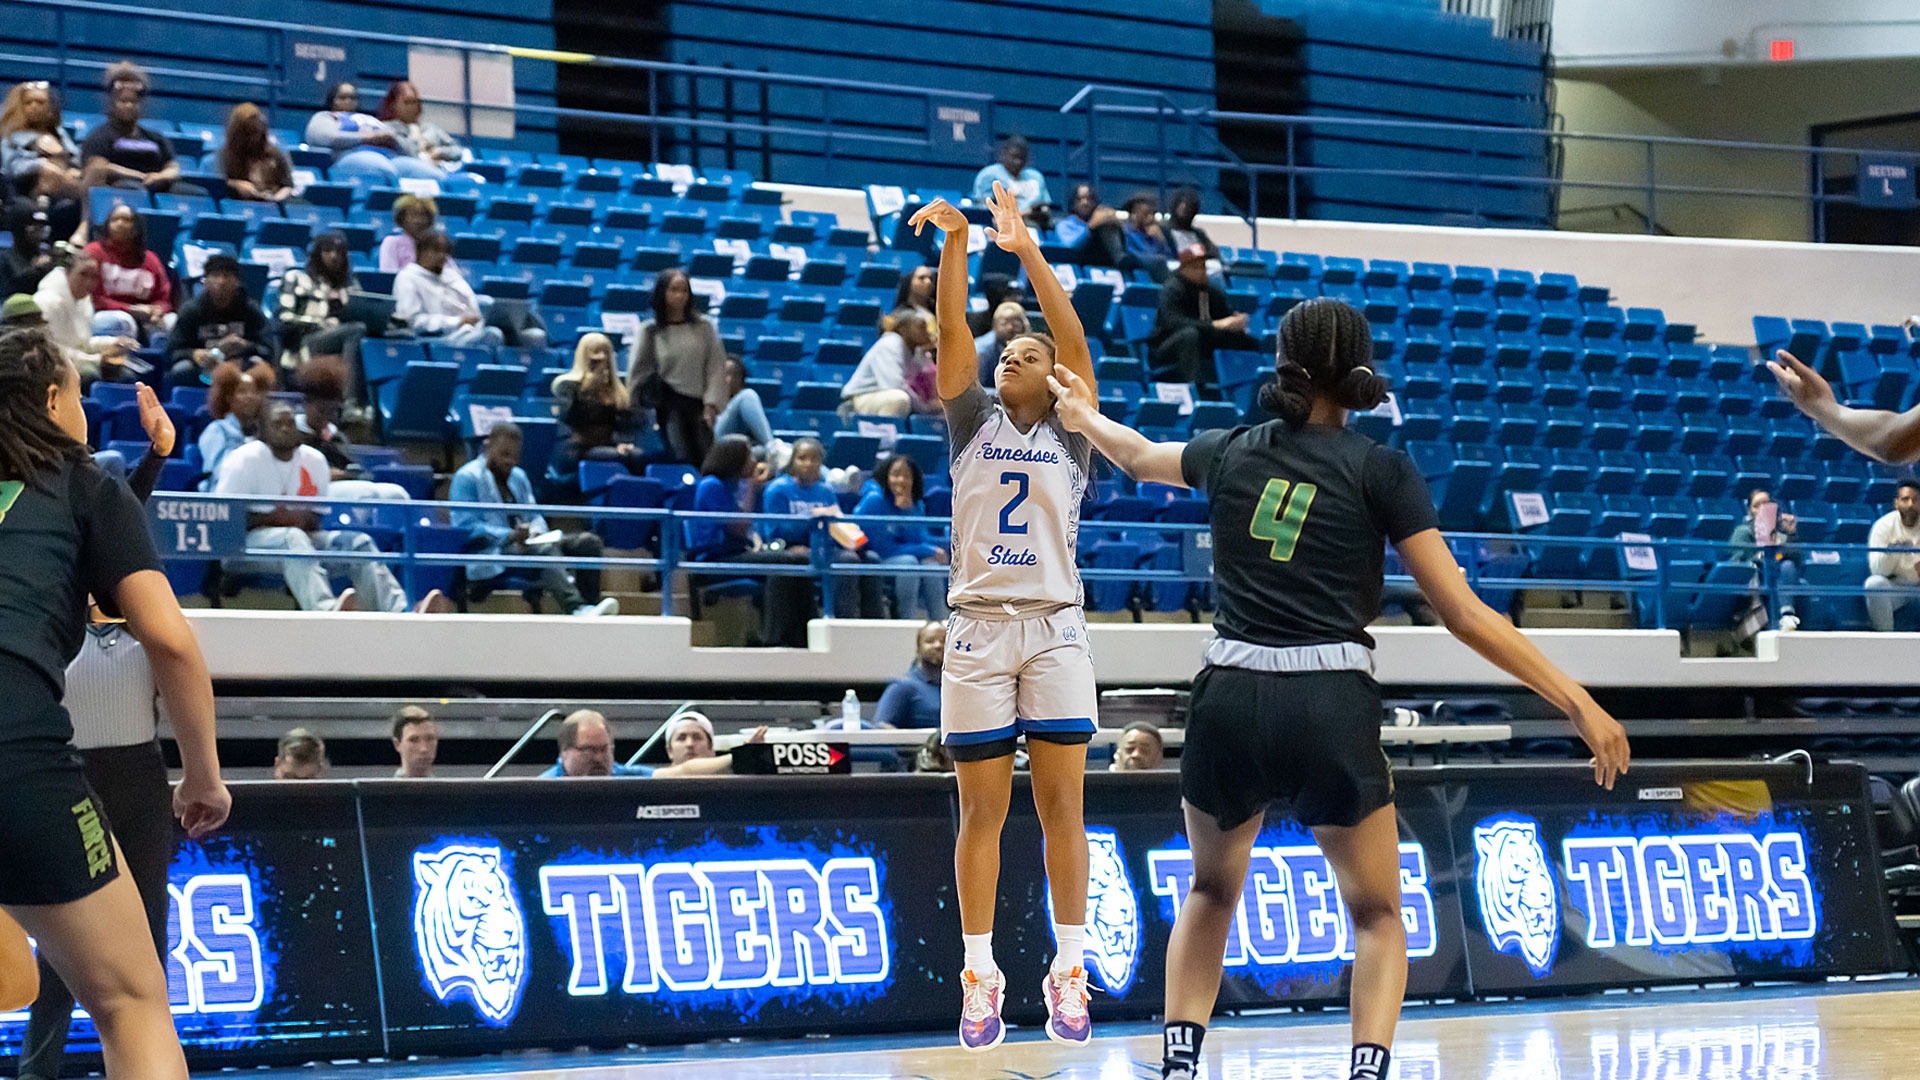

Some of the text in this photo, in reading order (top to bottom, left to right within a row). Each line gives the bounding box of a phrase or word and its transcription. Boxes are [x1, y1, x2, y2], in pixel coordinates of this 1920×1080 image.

[976, 442, 1060, 465] Tennessee
[157, 500, 230, 522] SECTION
[998, 470, 1030, 535] 2
[1249, 477, 1318, 562] 4
[987, 544, 1038, 567] State
[772, 743, 831, 766] POSS
[71, 797, 112, 880] FORCE
[538, 857, 889, 997] TIGERS
[1147, 842, 1437, 967] TGES
[1562, 832, 1817, 949] TIGERS
